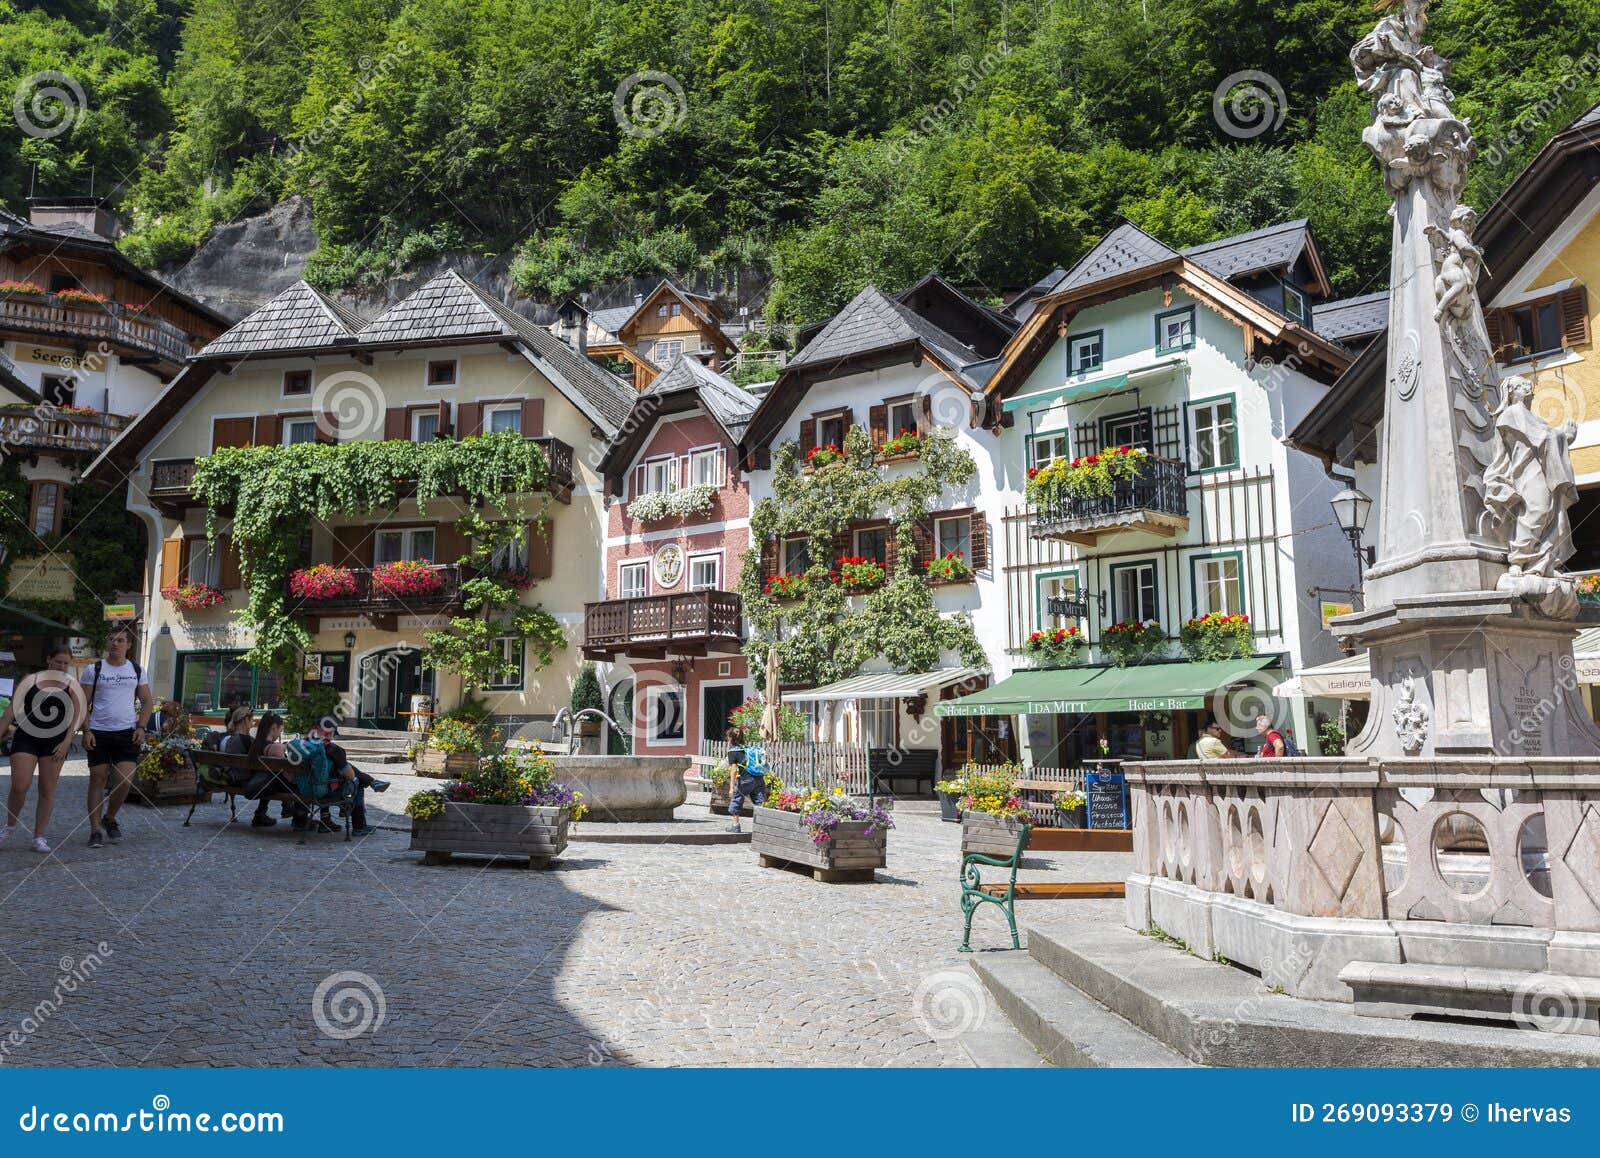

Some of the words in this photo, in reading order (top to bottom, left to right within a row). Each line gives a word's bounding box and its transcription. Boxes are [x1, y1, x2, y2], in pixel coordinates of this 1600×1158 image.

[946, 705, 969, 716] Hotel
[979, 704, 996, 715] Bar
[1053, 700, 1088, 713] MITT
[1128, 699, 1156, 710] Hotel
[1167, 698, 1187, 710] Bar
